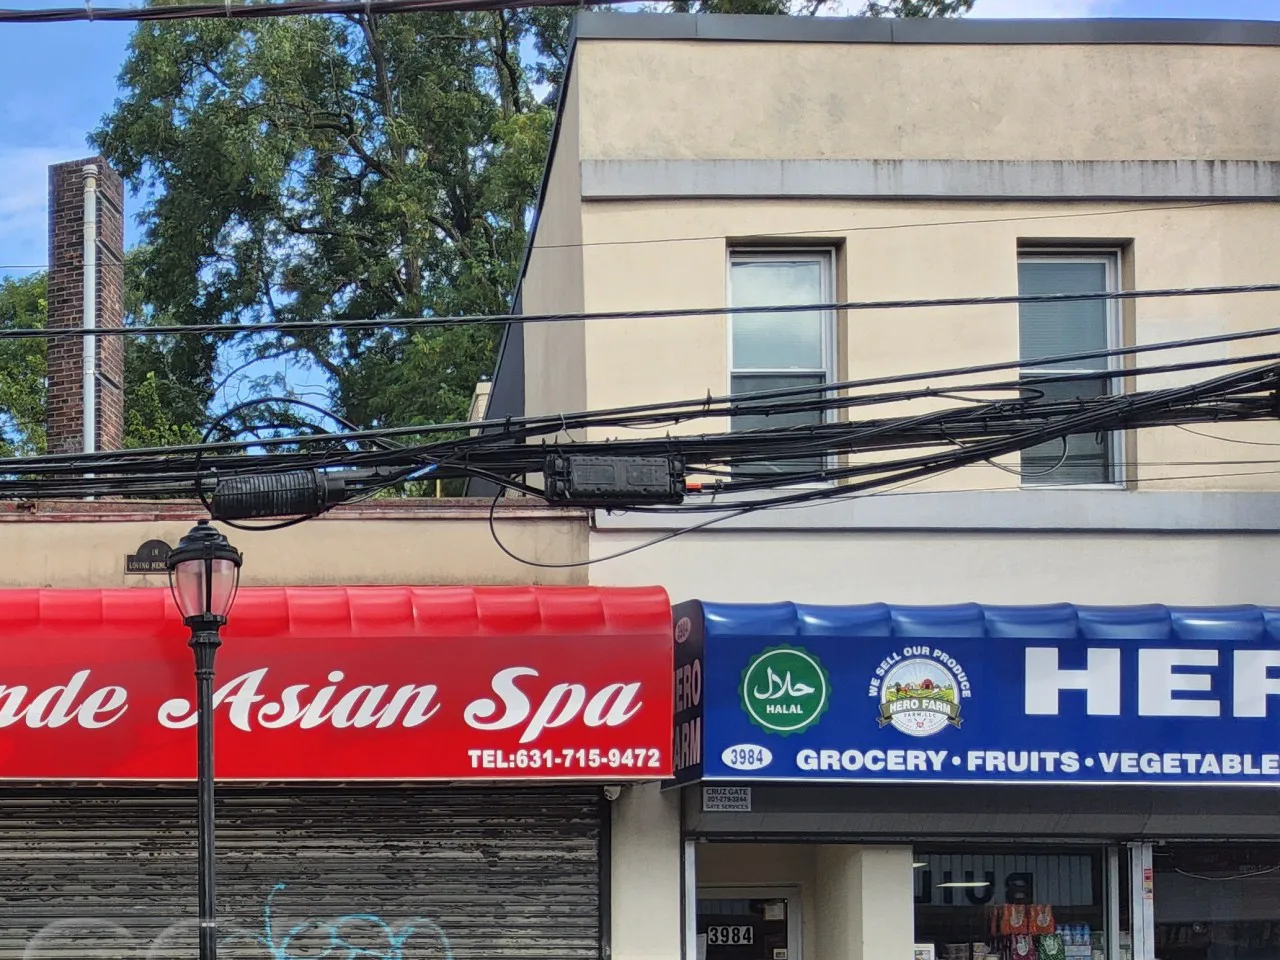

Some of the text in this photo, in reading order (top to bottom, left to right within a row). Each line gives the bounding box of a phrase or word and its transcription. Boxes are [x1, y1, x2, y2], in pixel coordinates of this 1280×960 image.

[754, 666, 815, 699] حلال
[868, 646, 972, 698] WE SELL OUR PRODUCE
[673, 659, 702, 714] ERO
[157, 667, 441, 733] Asian
[463, 666, 643, 744] Spa
[766, 704, 804, 714] HALAL
[889, 699, 952, 715] HERO FARM
[673, 717, 701, 770] ARM
[467, 749, 660, 768] TEL:631-715-9472
[730, 749, 763, 766] 3984
[796, 749, 949, 772] GROCERY
[967, 750, 1080, 773] FRUITS
[709, 926, 752, 944] 3984
